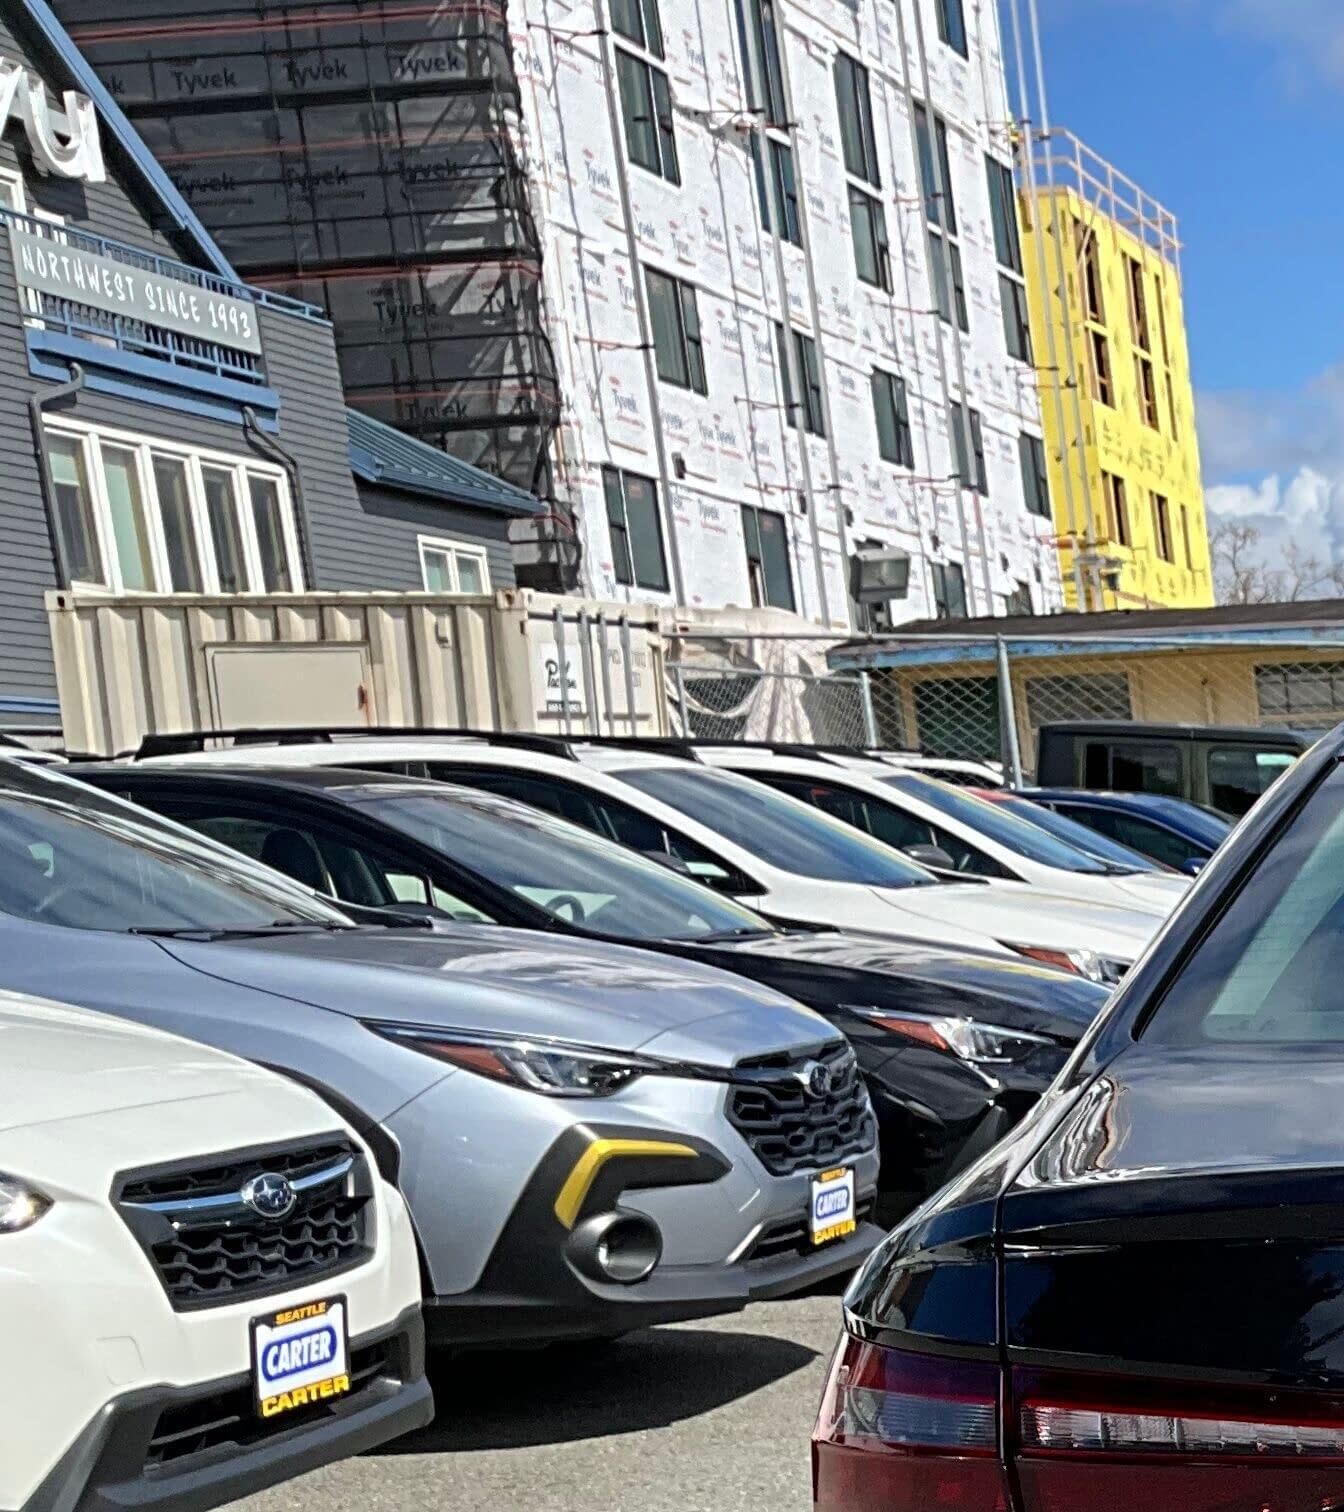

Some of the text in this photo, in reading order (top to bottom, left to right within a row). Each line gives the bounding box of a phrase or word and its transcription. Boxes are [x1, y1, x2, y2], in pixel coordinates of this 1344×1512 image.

[170, 67, 238, 96] Tyvek
[21, 245, 251, 338] NORTHWEST SINCE 1993
[275, 1301, 327, 1325] SEATTLE
[266, 1330, 332, 1377] CARTER
[262, 1375, 350, 1417] CARTER
